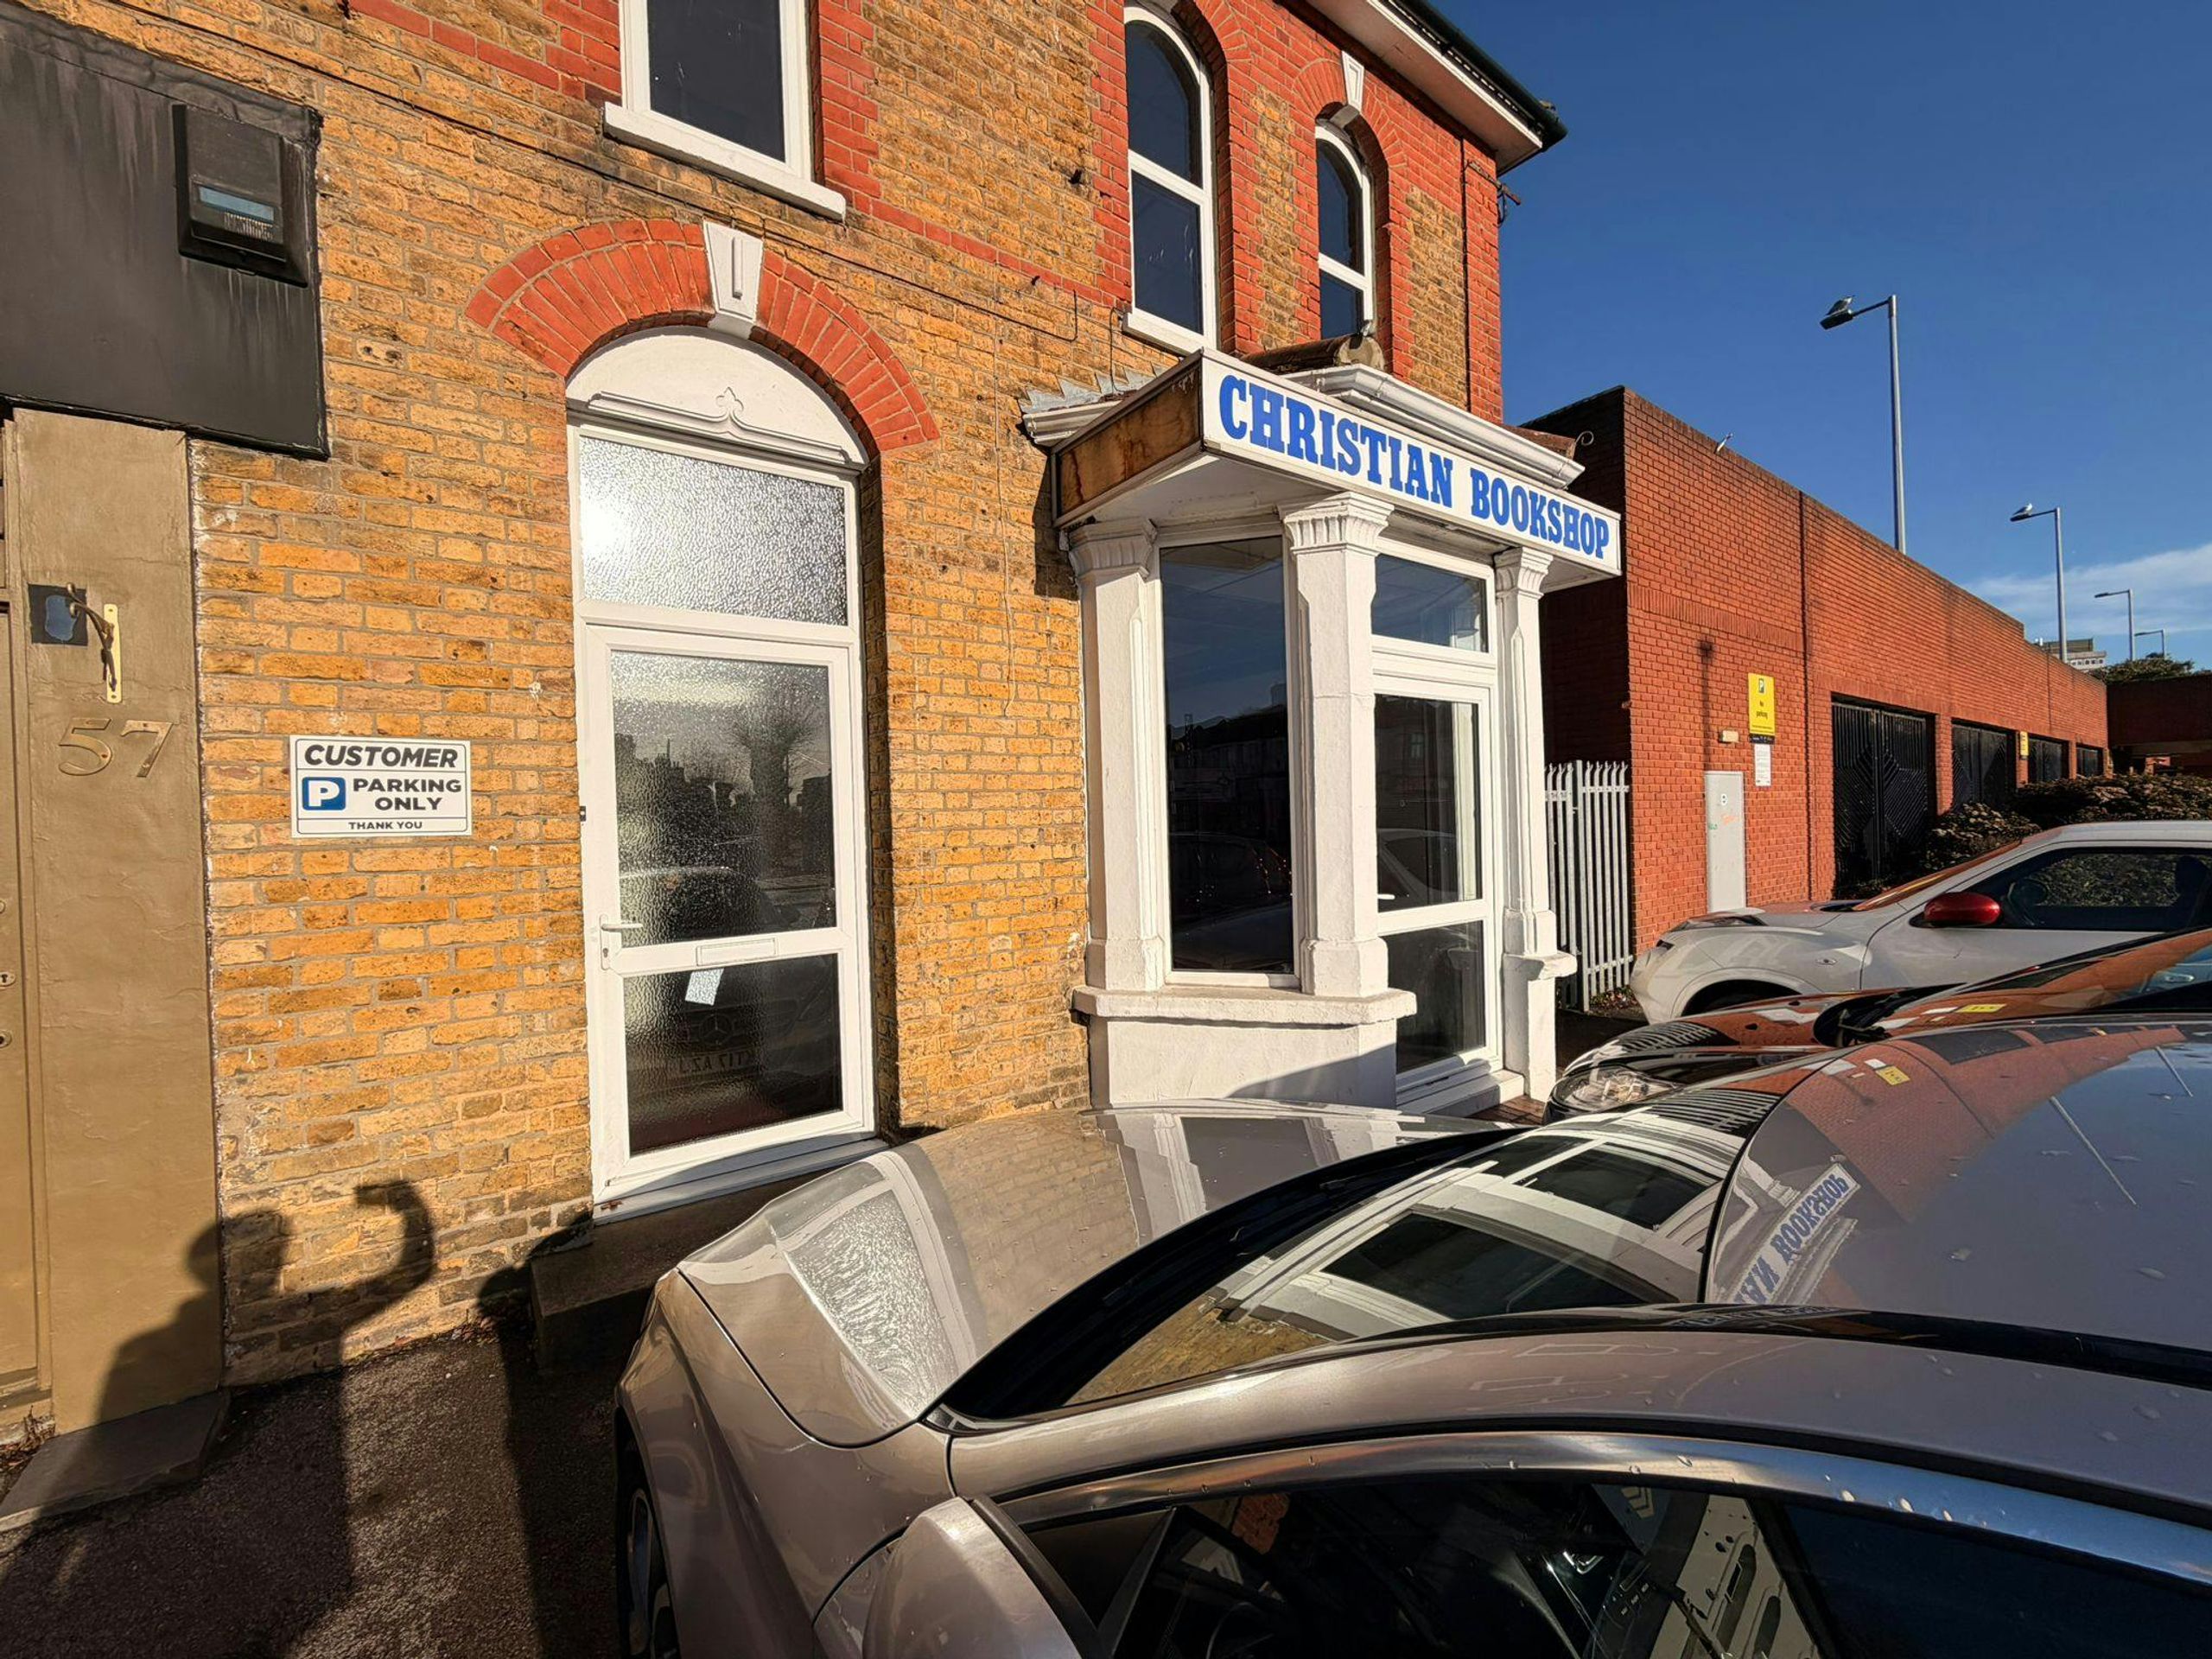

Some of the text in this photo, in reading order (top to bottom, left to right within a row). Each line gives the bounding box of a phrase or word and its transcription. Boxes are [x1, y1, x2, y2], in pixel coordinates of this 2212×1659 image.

[1219, 374, 1610, 560] CHRISTIAN BOOKSHOP
[58, 716, 173, 778] 57
[304, 744, 458, 768] CUSTOMER
[308, 779, 340, 807] P
[353, 778, 462, 793] PARKING
[374, 797, 443, 811] ONLY
[348, 821, 423, 830] THANK YOU
